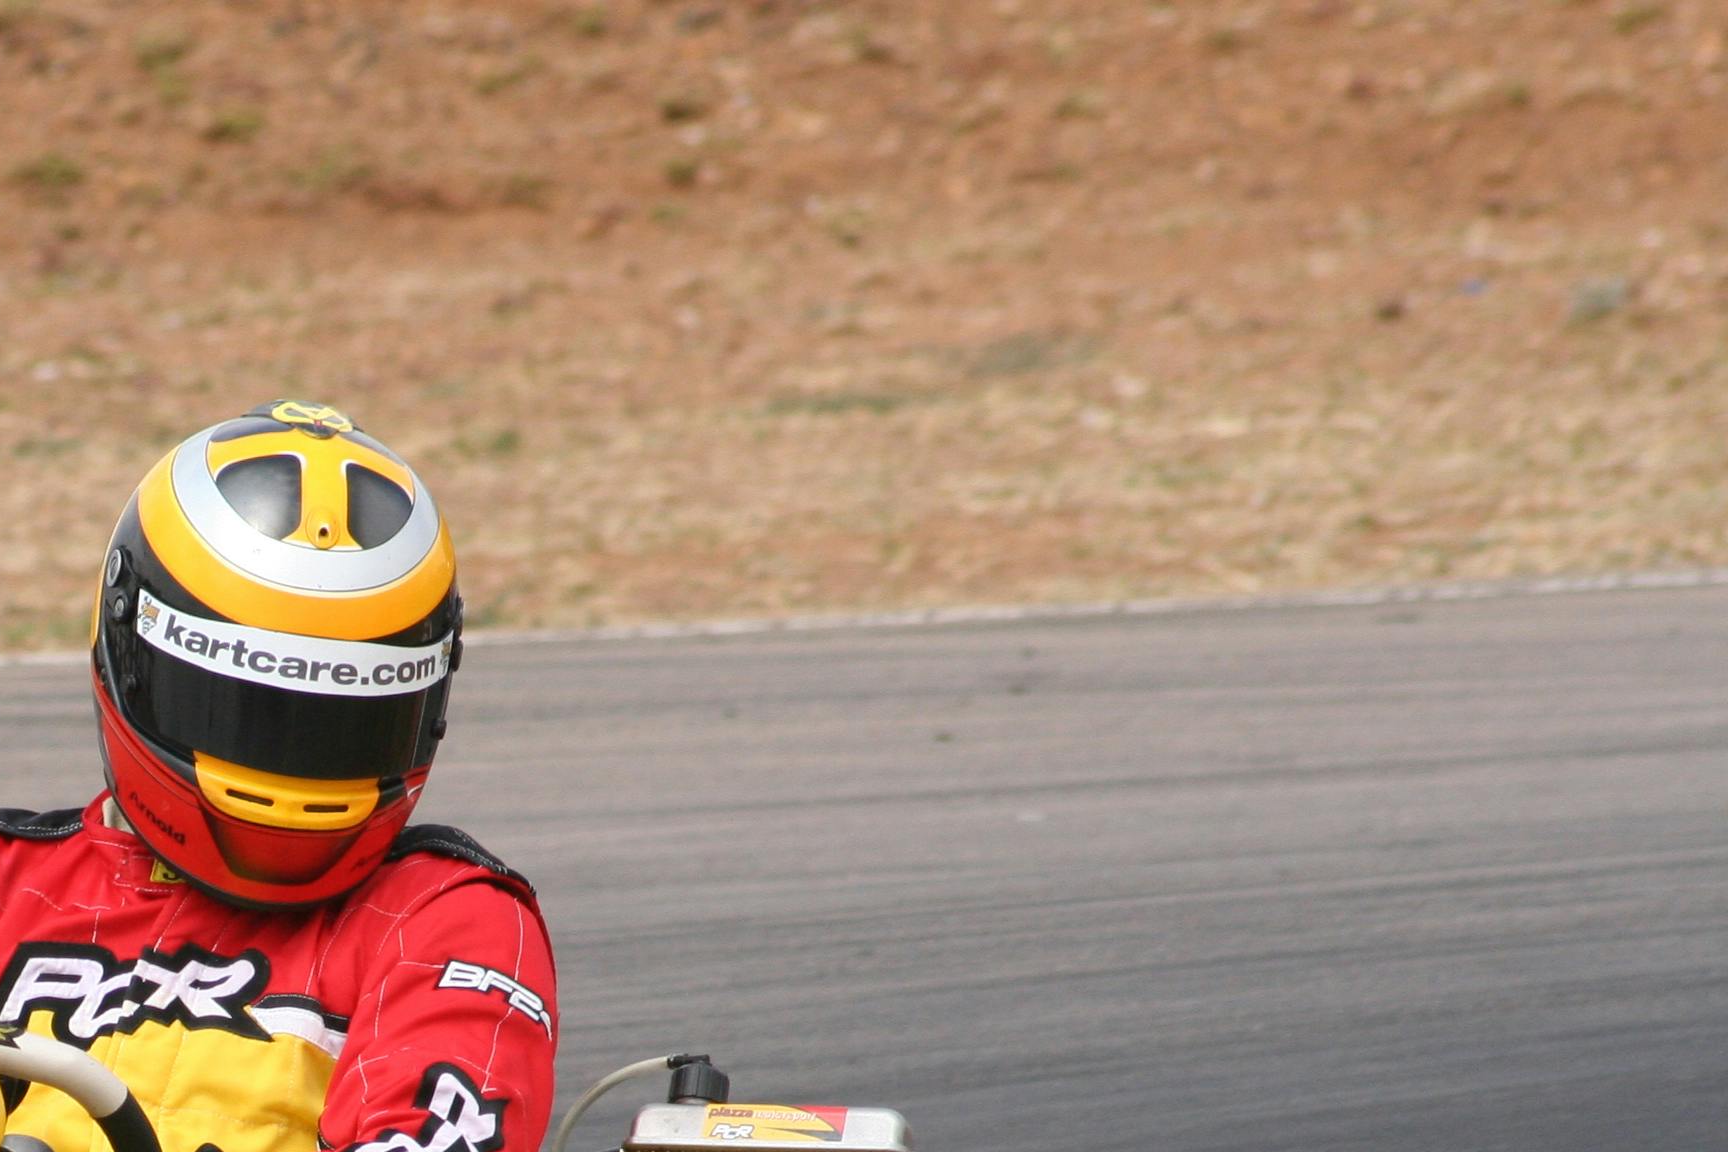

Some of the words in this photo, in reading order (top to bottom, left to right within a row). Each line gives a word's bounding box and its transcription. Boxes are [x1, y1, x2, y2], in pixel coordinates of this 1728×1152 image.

[164, 614, 436, 686] kartcare.com
[1, 955, 256, 1040] PCR
[712, 1124, 753, 1139] PCR
